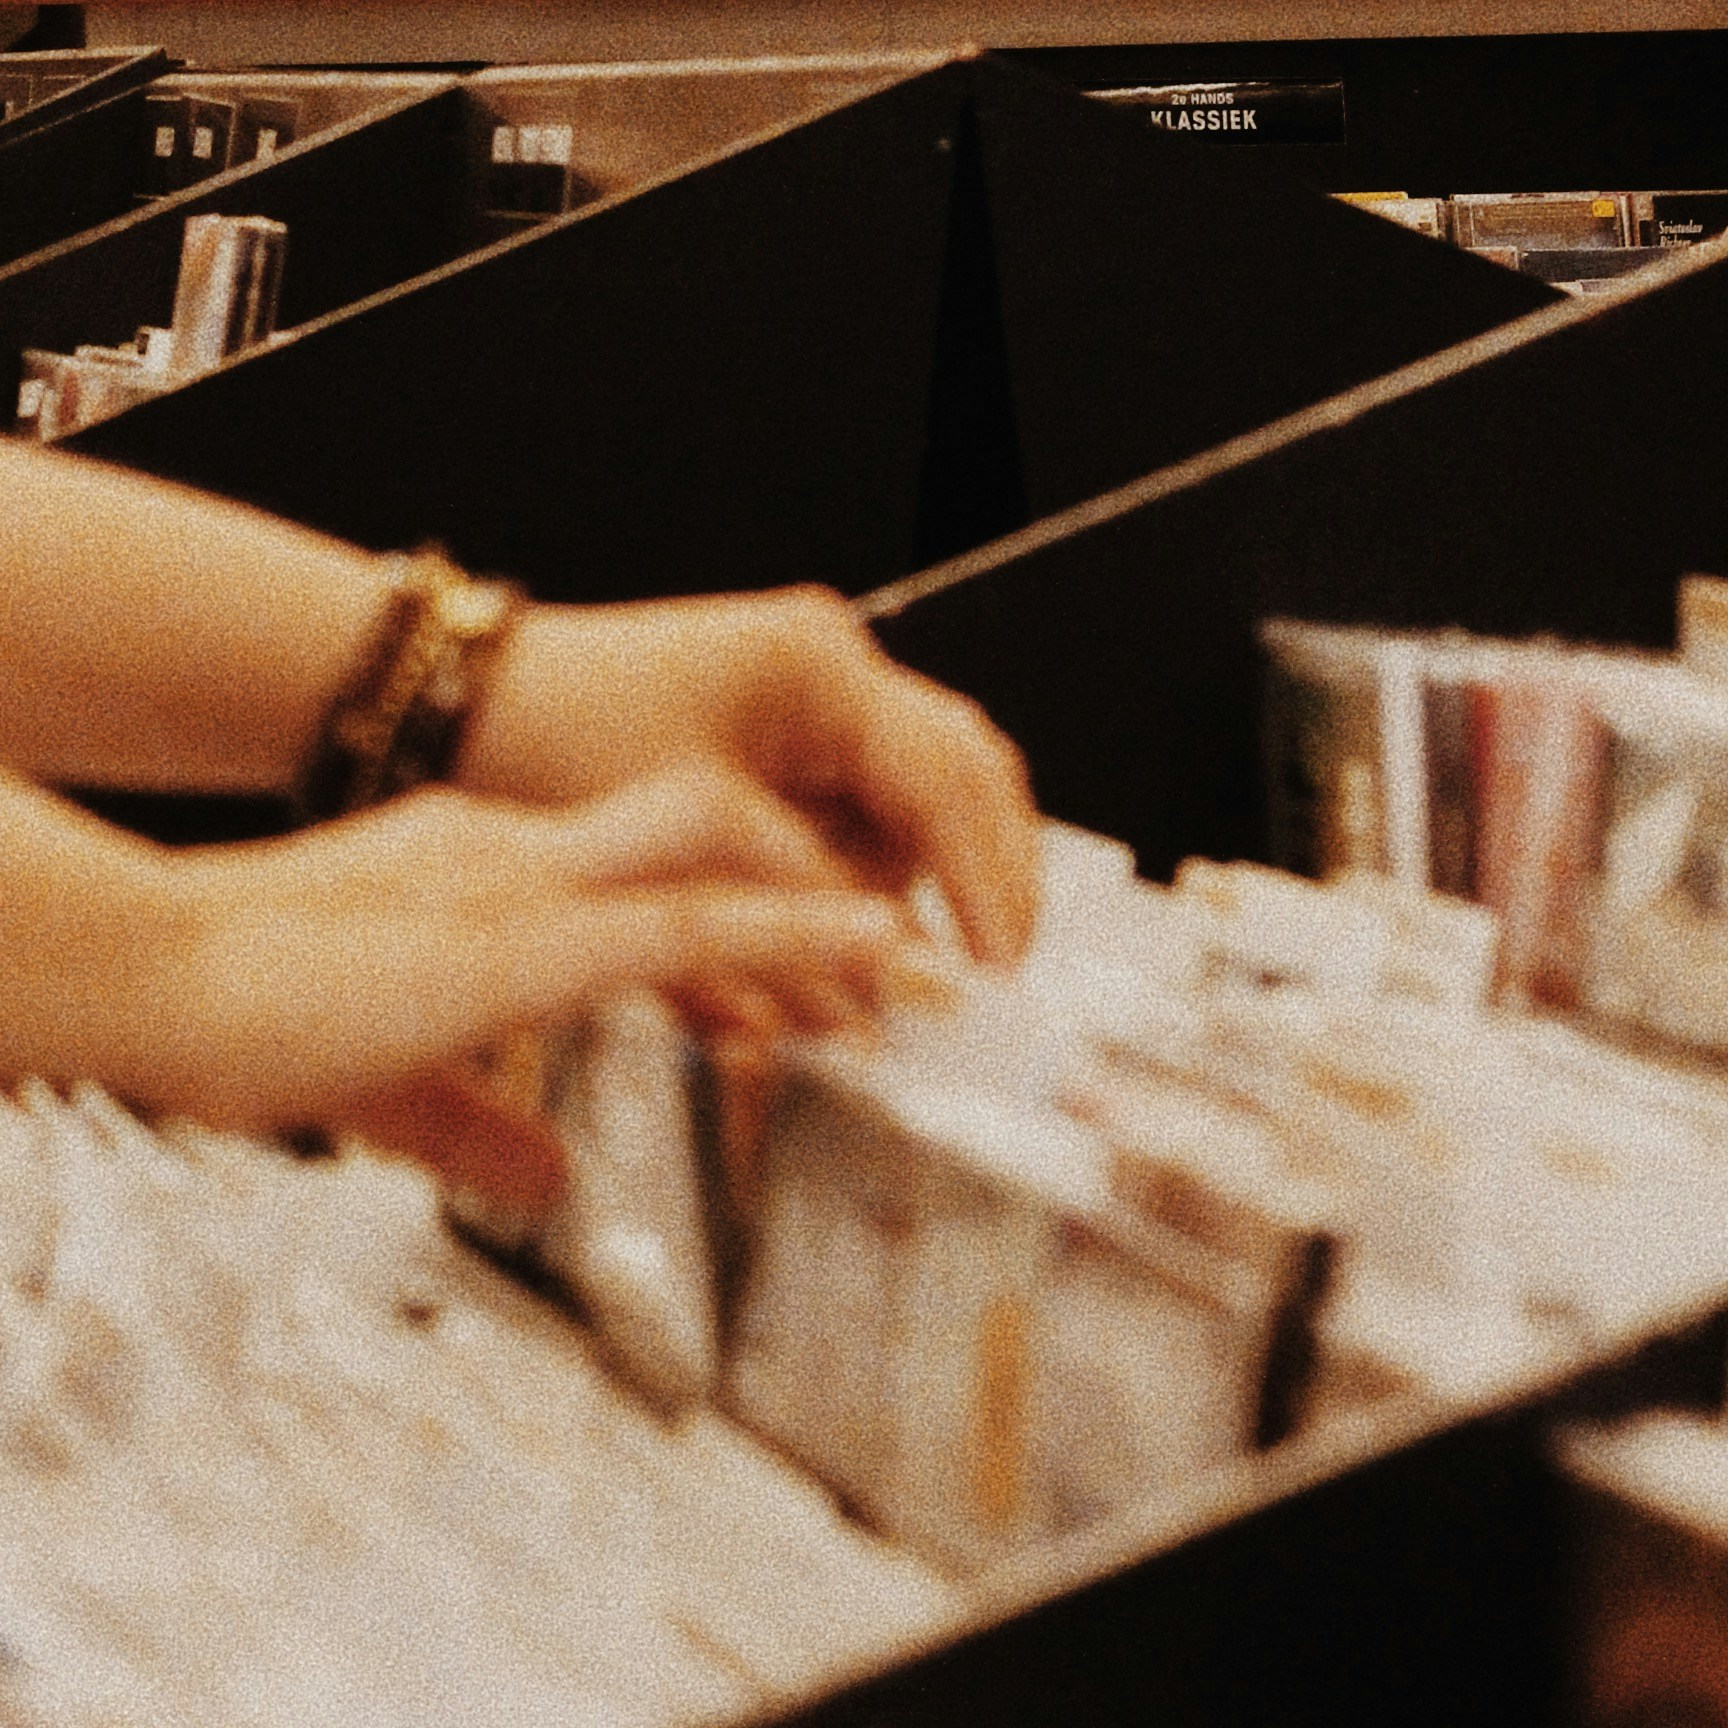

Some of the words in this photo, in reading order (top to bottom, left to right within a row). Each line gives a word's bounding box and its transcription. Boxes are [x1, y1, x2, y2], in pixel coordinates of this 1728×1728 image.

[1190, 92, 1235, 105] HANDS
[1150, 109, 1260, 132] KLASSIEK
[1658, 218, 1703, 234] Sviatoslav
